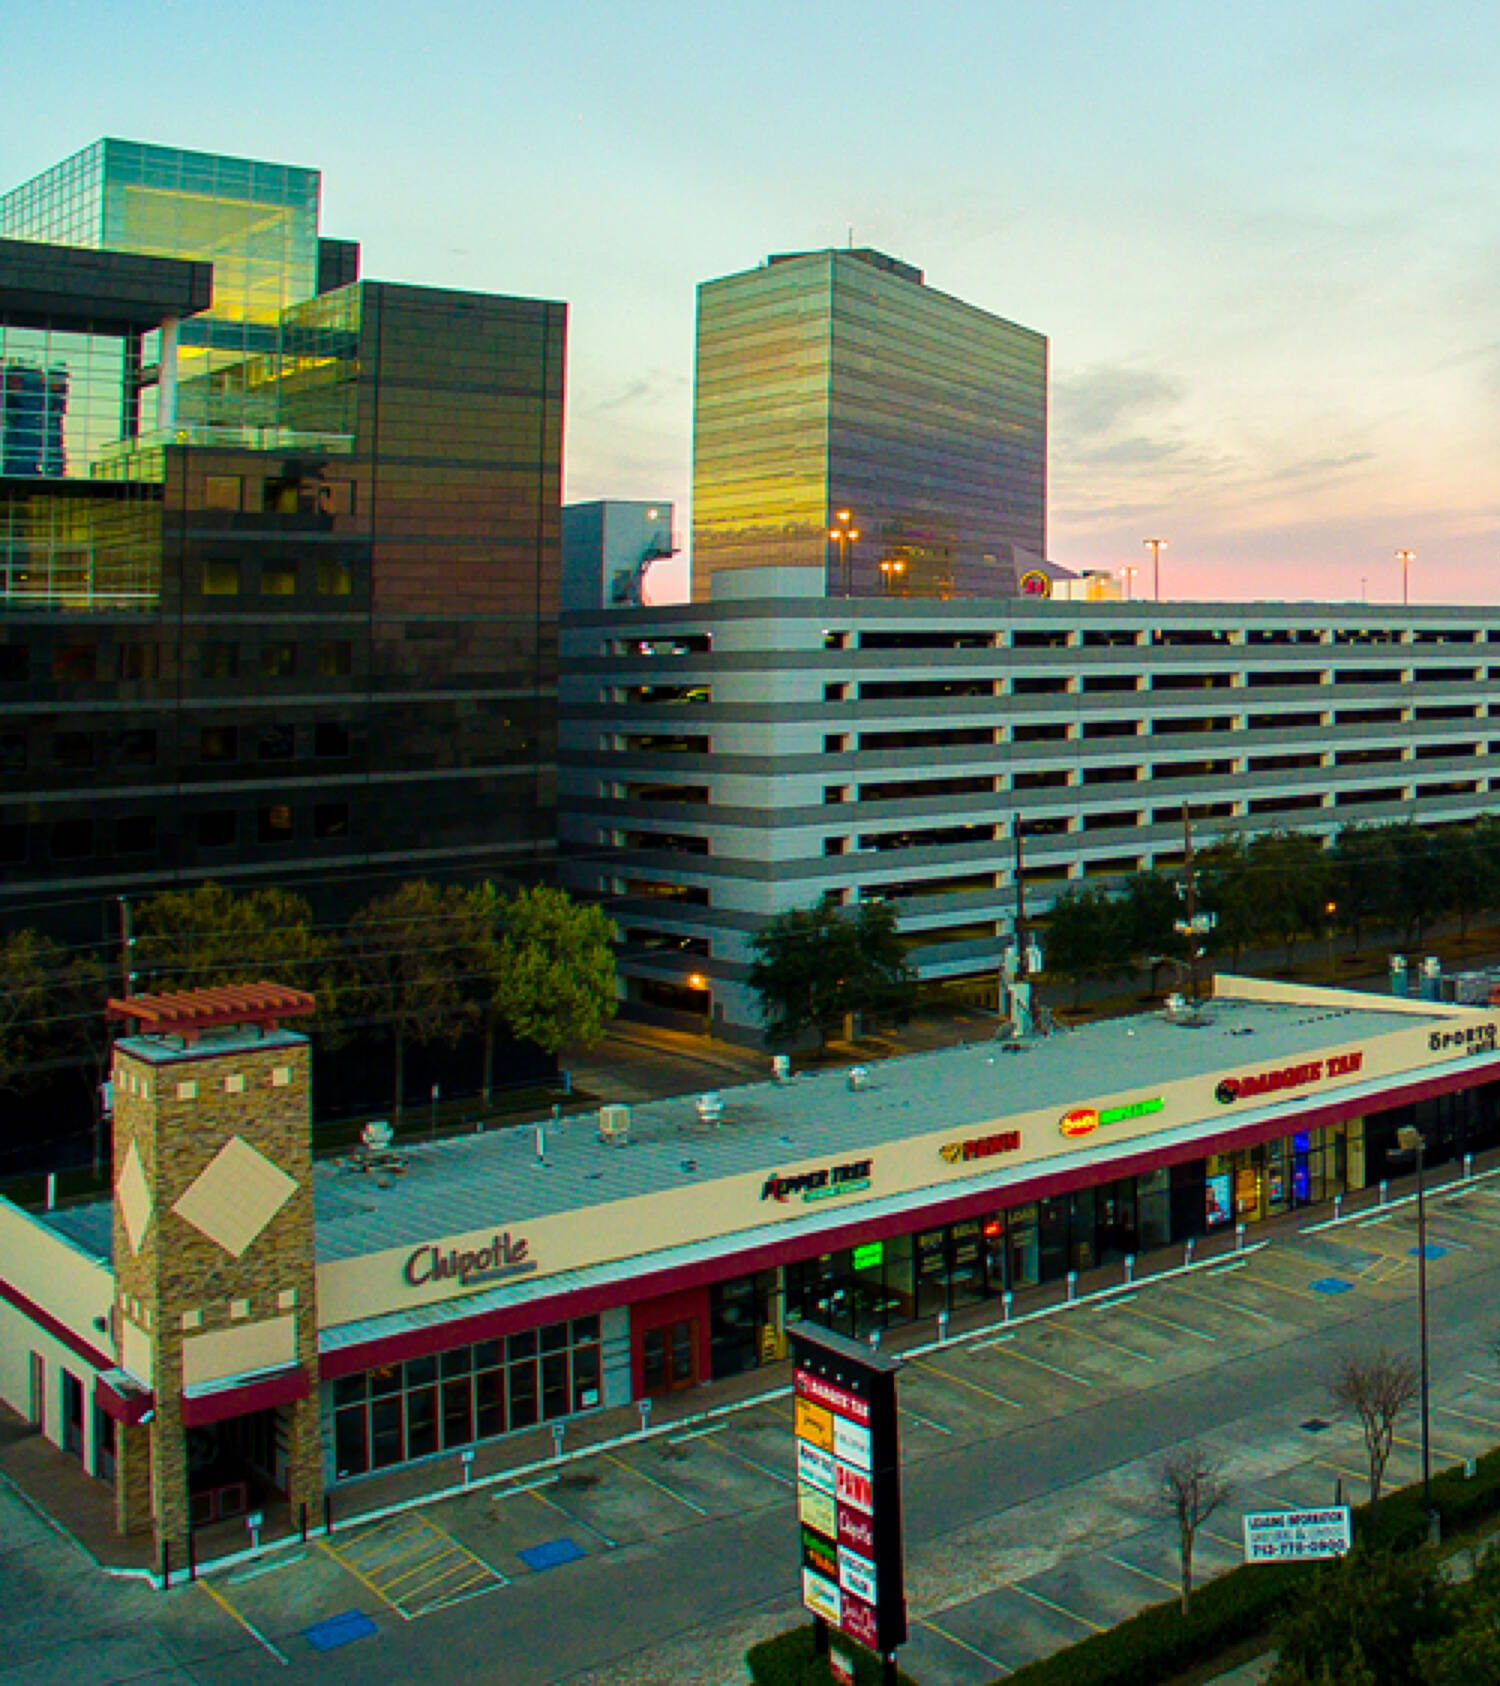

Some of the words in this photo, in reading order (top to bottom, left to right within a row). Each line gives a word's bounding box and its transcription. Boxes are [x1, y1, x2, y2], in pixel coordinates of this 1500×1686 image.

[1326, 1050, 1363, 1078] TAN
[962, 1131, 1021, 1161] PAWN
[405, 1232, 529, 1287] Chipotle
